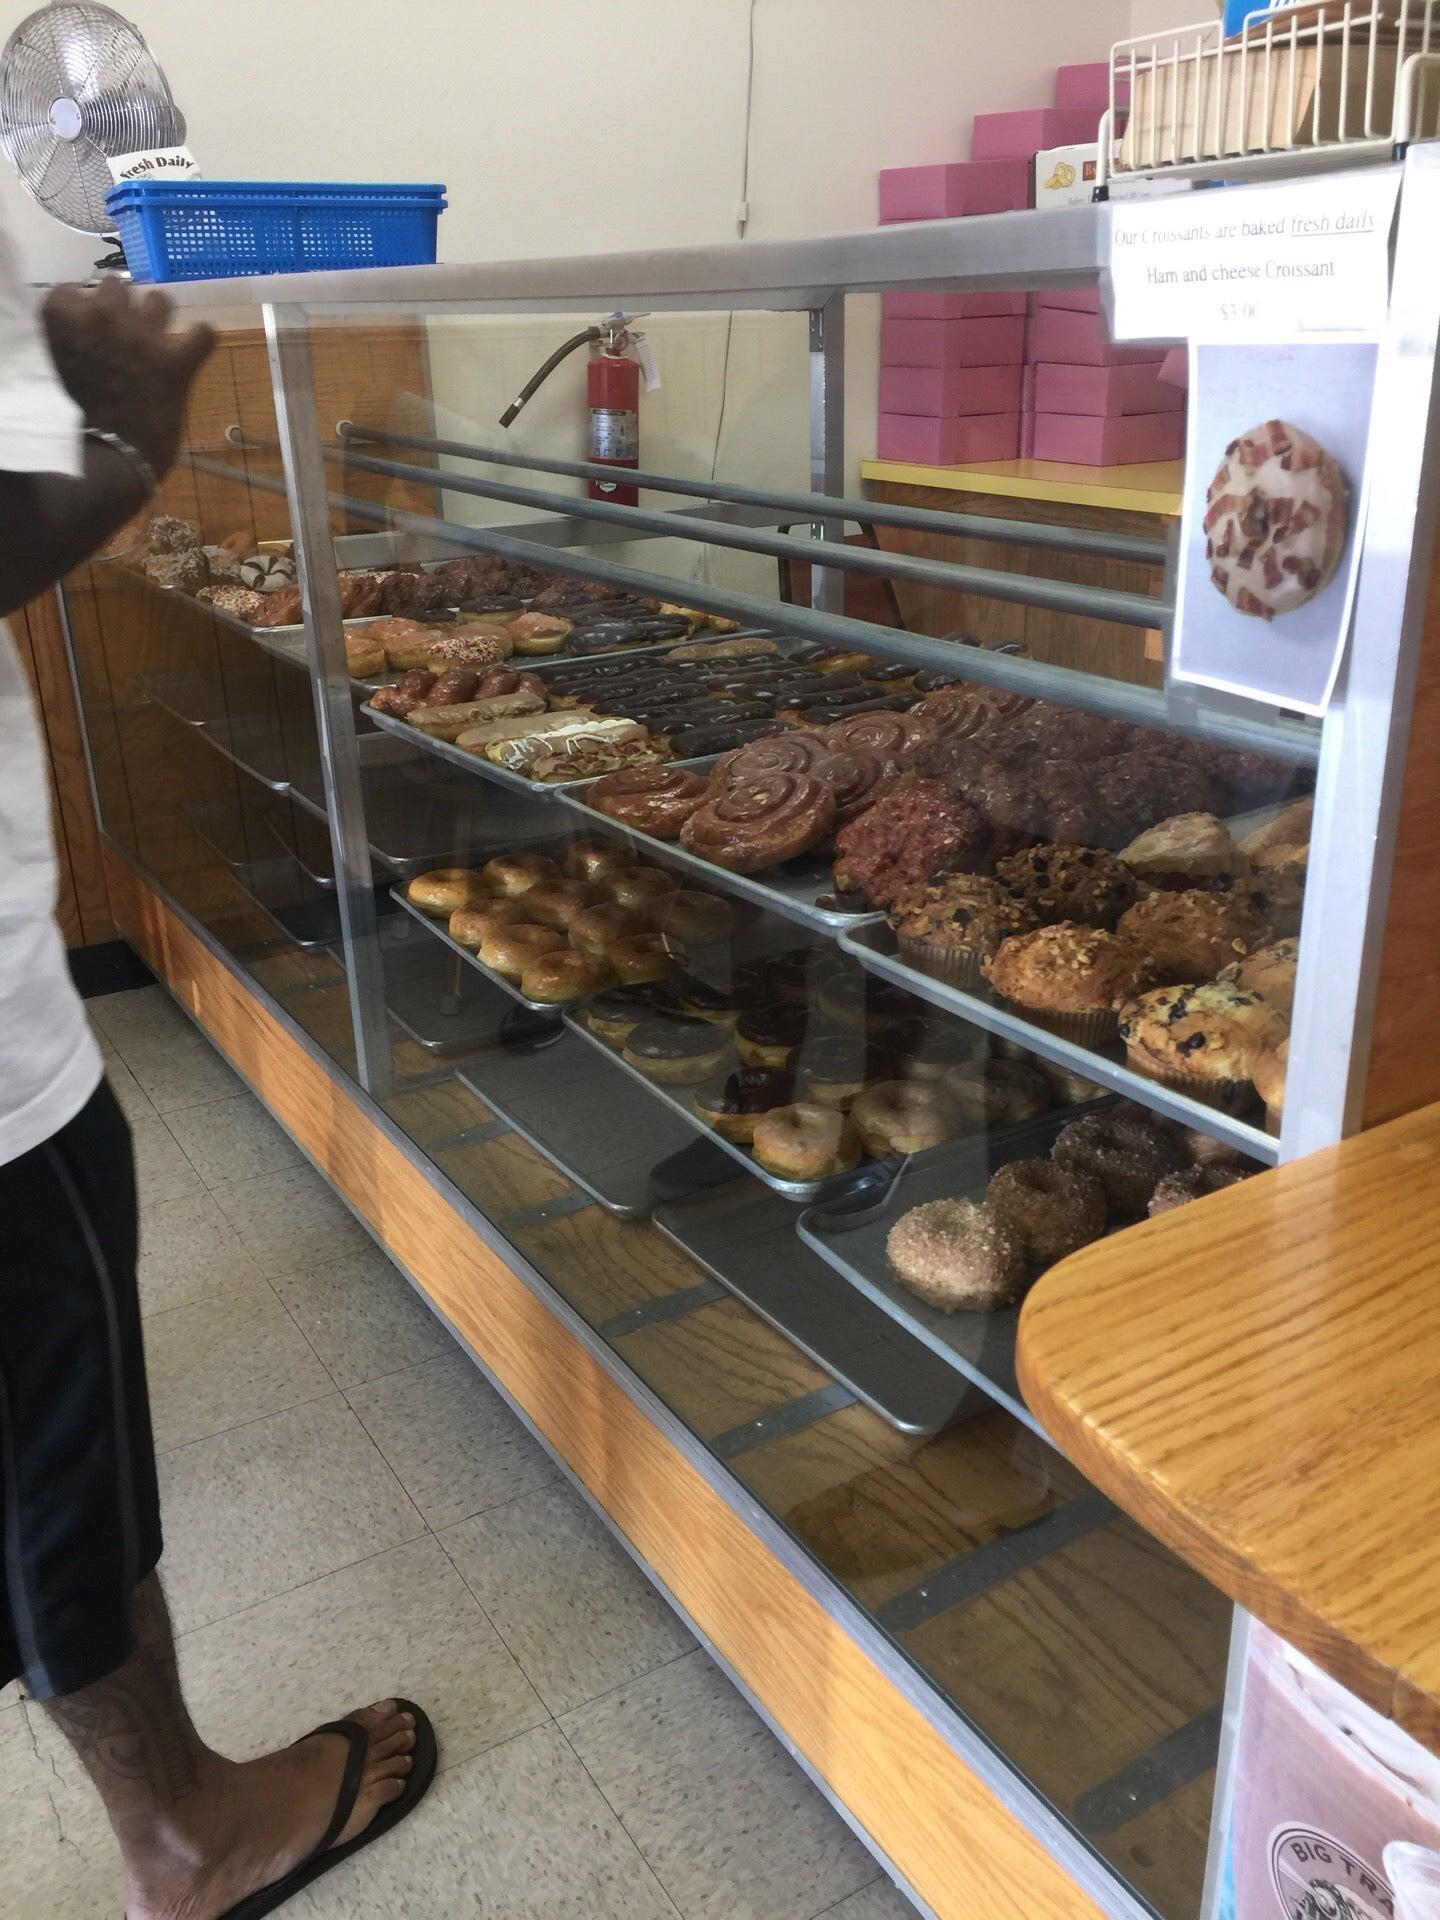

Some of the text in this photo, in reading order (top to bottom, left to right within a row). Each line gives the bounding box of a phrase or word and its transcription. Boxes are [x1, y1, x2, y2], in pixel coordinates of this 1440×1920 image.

[155, 155, 194, 169] Daily
[1114, 210, 1375, 247] Our Croissants are baked fresh daily
[1147, 259, 1336, 284] Ham and cheese Croissant
[1290, 1842, 1333, 1864] BIG
